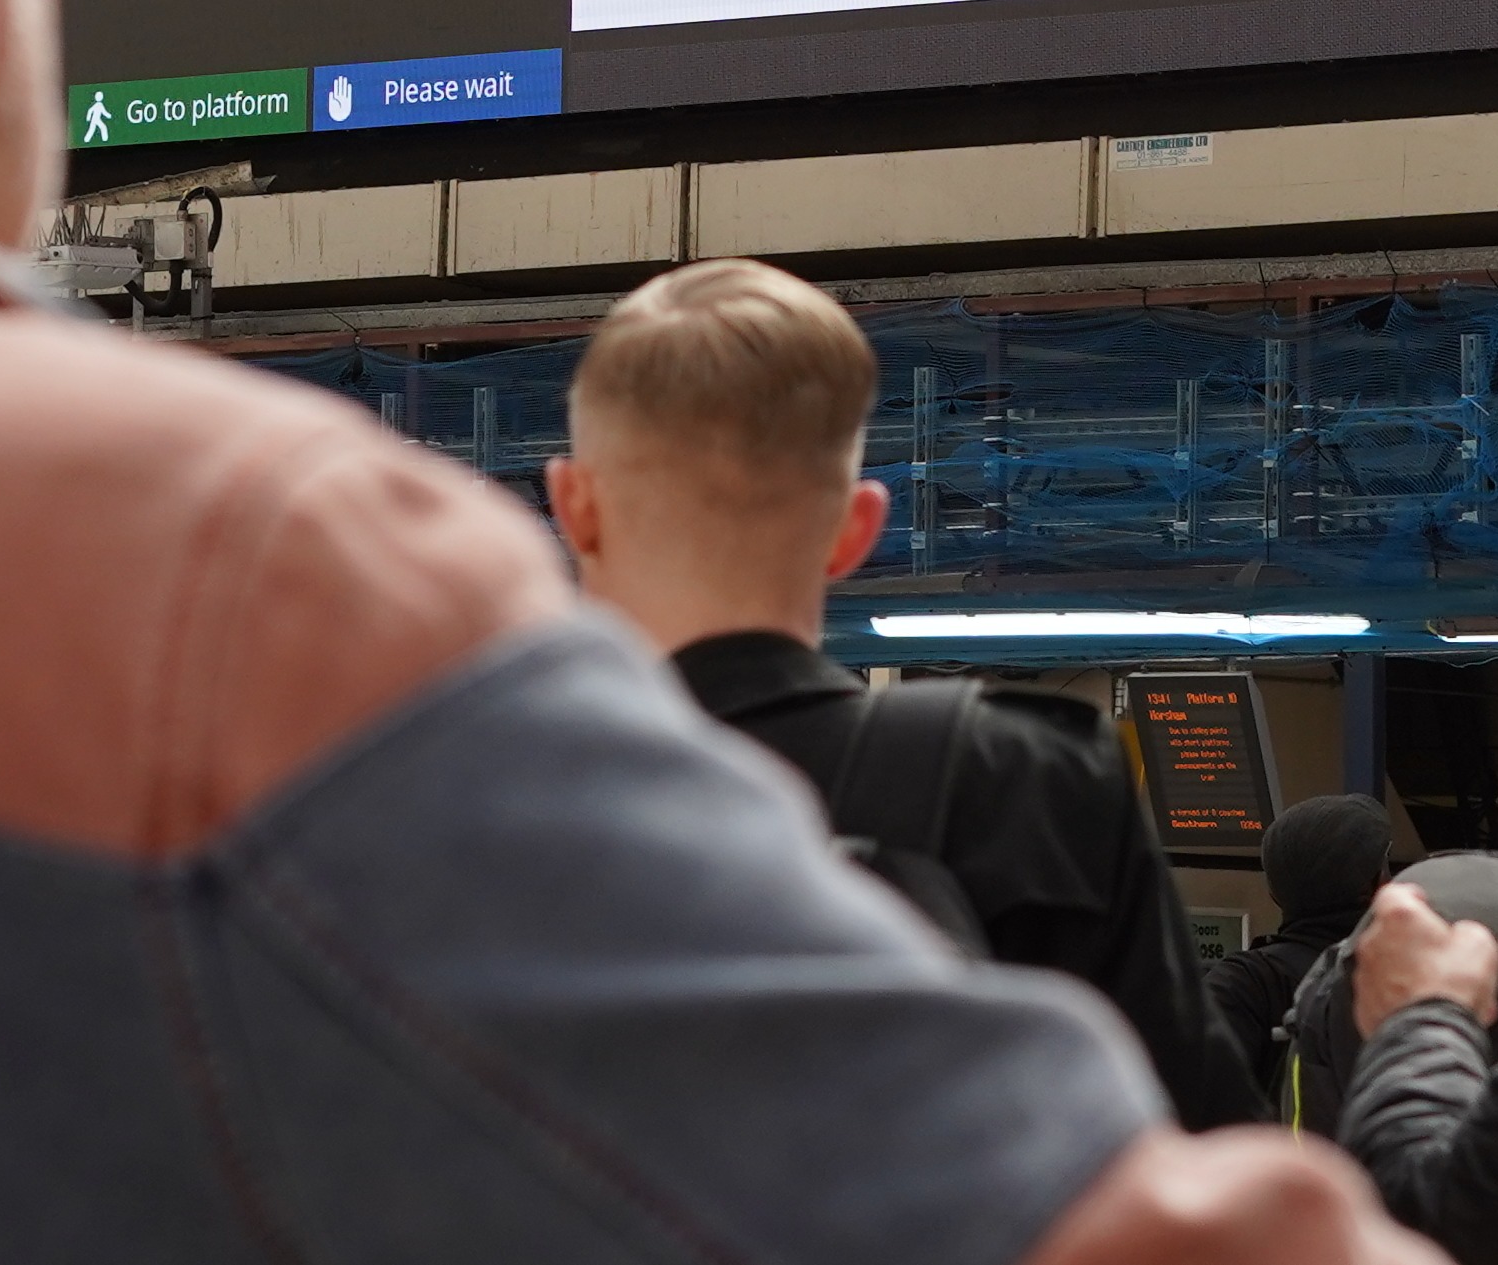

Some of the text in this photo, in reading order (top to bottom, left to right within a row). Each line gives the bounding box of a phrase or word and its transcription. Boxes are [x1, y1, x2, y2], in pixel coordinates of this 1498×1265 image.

[385, 70, 514, 105] Please wait
[126, 90, 289, 127] Go to platform
